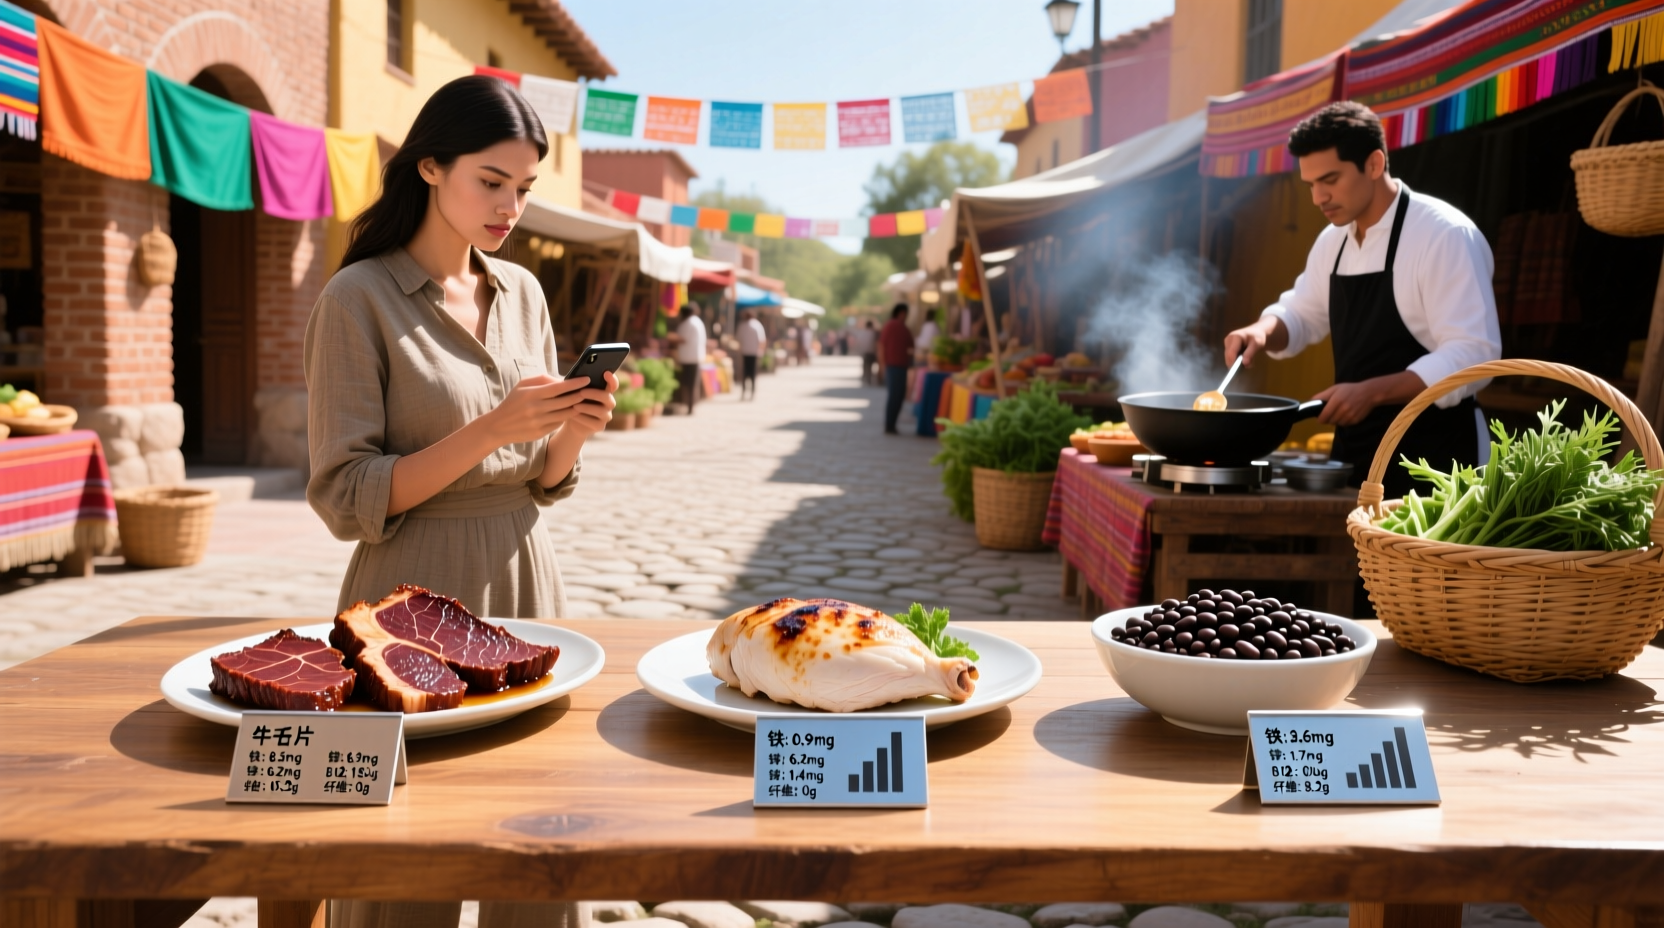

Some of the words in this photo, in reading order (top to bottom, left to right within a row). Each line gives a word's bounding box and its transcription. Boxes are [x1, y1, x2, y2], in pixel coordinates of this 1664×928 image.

[792, 733, 835, 750] 0.9mg
[789, 753, 825, 768] 6.2mg
[802, 785, 817, 800] 0g
